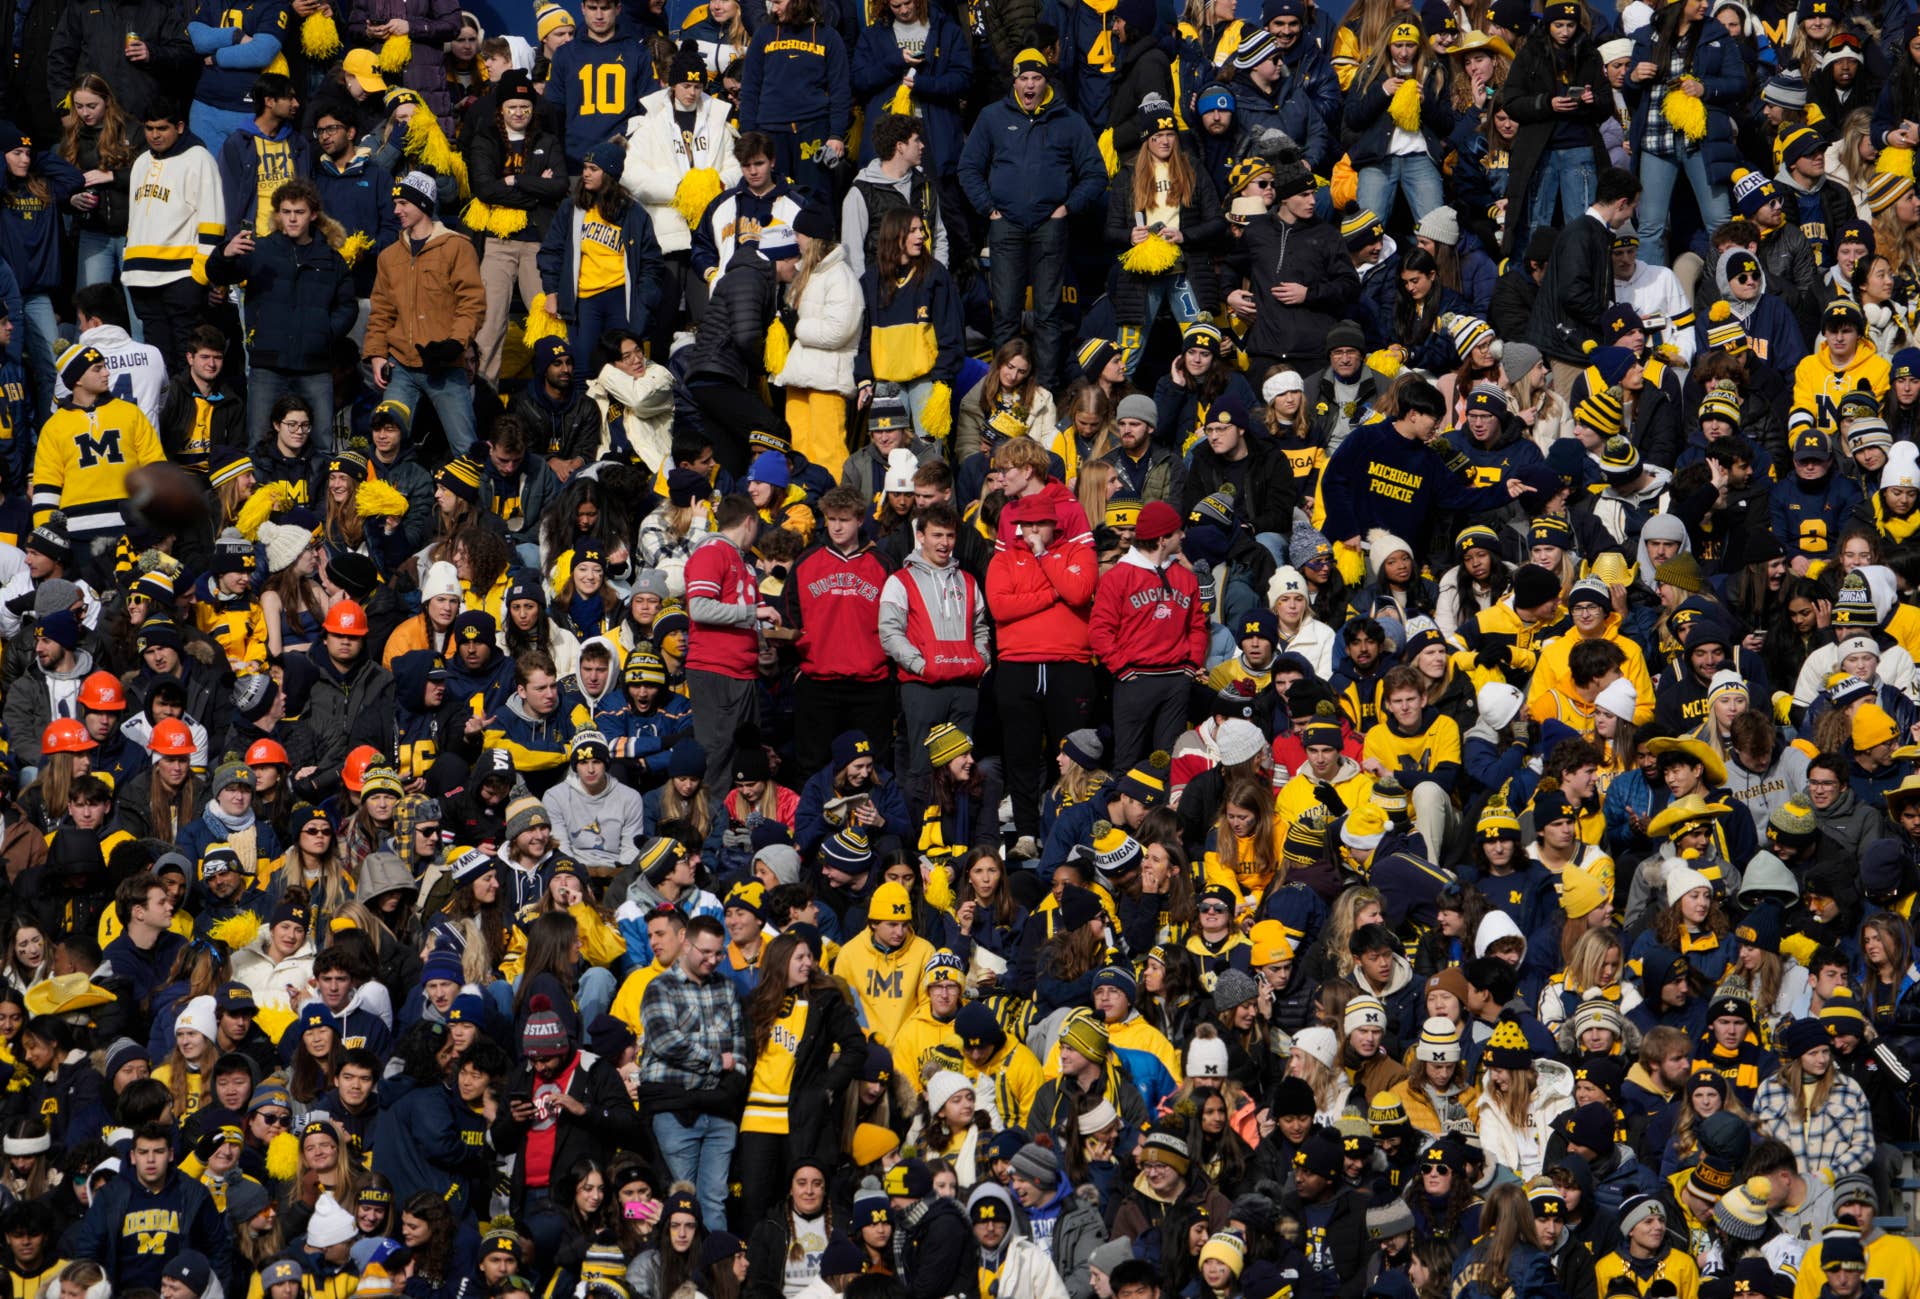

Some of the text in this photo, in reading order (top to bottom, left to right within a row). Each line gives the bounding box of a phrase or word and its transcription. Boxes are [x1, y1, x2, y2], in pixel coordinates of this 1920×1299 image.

[1814, 3, 1826, 12] M
[1398, 27, 1410, 36] M
[1761, 19, 1787, 47] M
[764, 41, 826, 56] MICHIGAN
[1087, 30, 1116, 73] 4
[688, 72, 700, 80] M
[579, 63, 626, 115] 10
[398, 94, 412, 102] M
[1158, 118, 1173, 128] M
[800, 139, 822, 160] M
[1760, 183, 1775, 196] M
[582, 223, 624, 253] MCHIGAN
[1744, 262, 1756, 271] M
[1121, 326, 1141, 349] H
[1196, 336, 1209, 346] M
[553, 346, 564, 354] M
[102, 352, 149, 369] RBAUGH
[879, 418, 890, 427] M
[1805, 438, 1818, 446] M
[75, 430, 124, 468] M
[1368, 461, 1423, 489] MICHIGAN
[279, 480, 309, 503] M
[1370, 481, 1414, 503] POOKIE
[1116, 514, 1127, 522] M
[1536, 530, 1547, 538] M
[1462, 538, 1473, 549] M
[586, 551, 598, 559] M
[242, 556, 255, 566] M
[809, 572, 878, 601] BUCKEYES
[1286, 582, 1298, 590] M
[1836, 612, 1849, 622] M
[1246, 622, 1259, 632] M
[1426, 630, 1439, 639] M
[1724, 682, 1742, 690] M
[855, 741, 869, 752] M
[577, 747, 592, 759] M
[236, 770, 248, 779] M
[1732, 780, 1785, 802] MICHGAN
[1485, 828, 1499, 838] M
[1510, 891, 1522, 904] M
[893, 904, 905, 914] M
[935, 970, 949, 982] M
[310, 1016, 321, 1025] M
[1366, 1013, 1378, 1022] M
[529, 1022, 559, 1035] STATE
[1433, 1052, 1446, 1061] M
[1205, 1065, 1217, 1074] M
[1575, 1070, 1587, 1079] M
[306, 1124, 321, 1133] M
[1344, 1139, 1358, 1150] M
[1428, 1150, 1442, 1160] M
[980, 1206, 994, 1218] M
[1544, 1202, 1558, 1212] M
[872, 1210, 886, 1222] M
[138, 1232, 167, 1254] M
[498, 1238, 512, 1250] M
[1735, 1280, 1750, 1291] M
